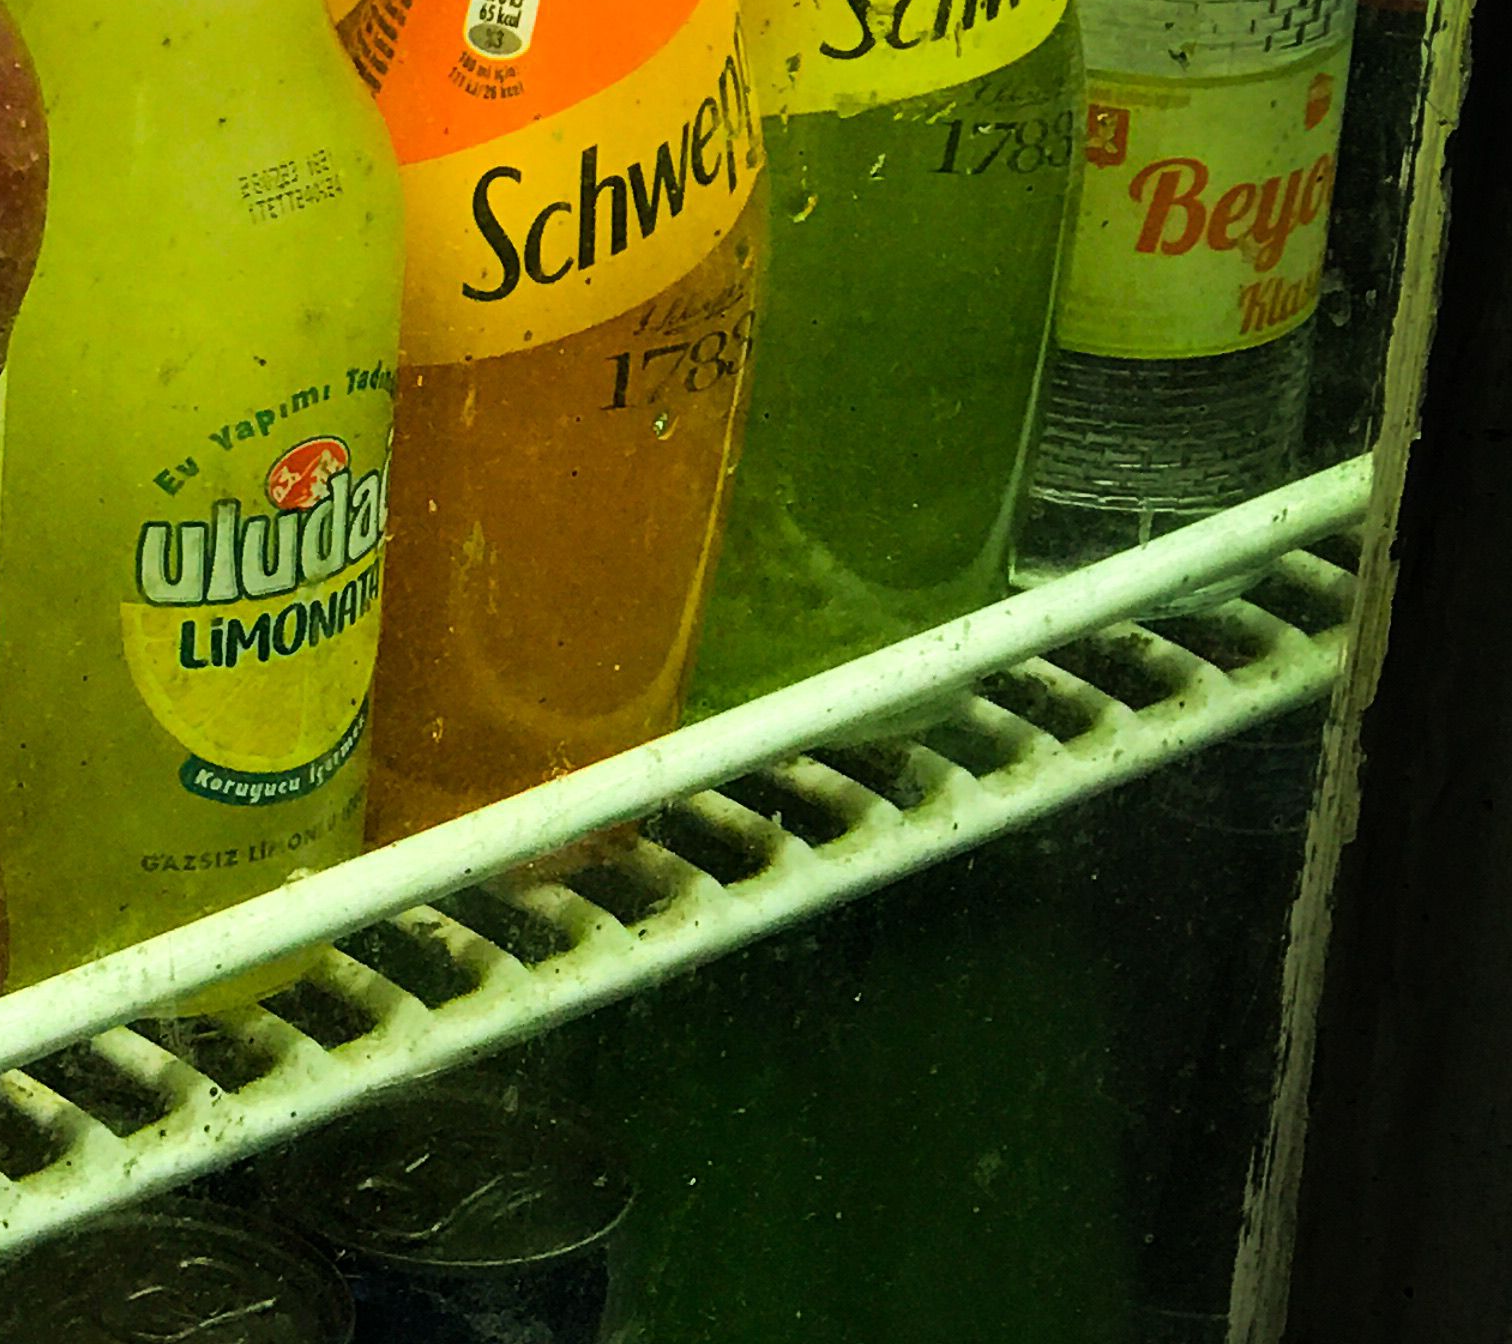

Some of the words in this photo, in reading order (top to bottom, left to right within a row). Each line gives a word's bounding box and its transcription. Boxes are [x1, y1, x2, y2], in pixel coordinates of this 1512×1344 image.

[479, 5, 495, 22] 65
[152, 456, 200, 497] Ev
[194, 766, 301, 804] Koruyucu
